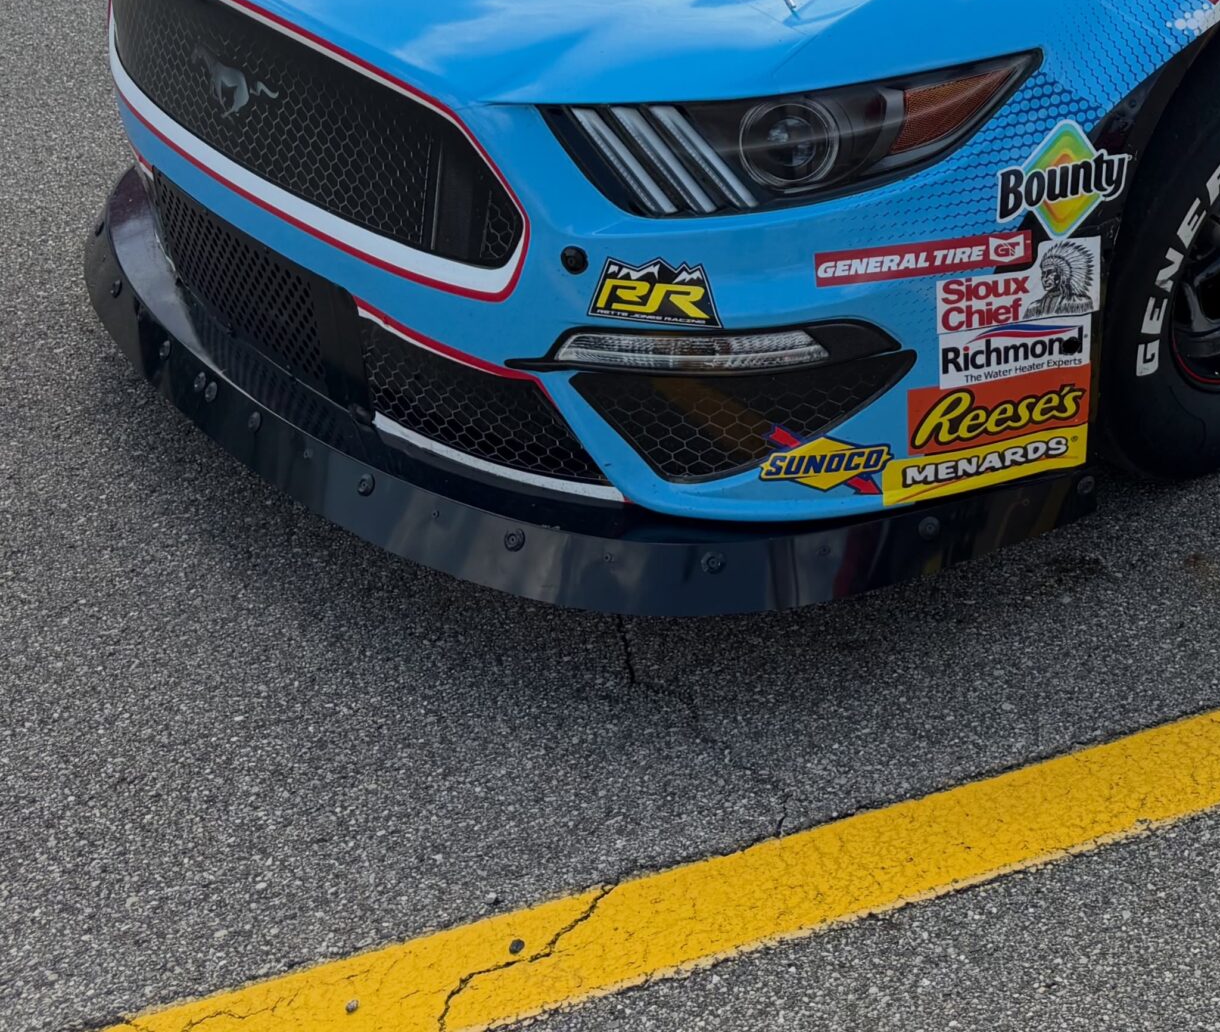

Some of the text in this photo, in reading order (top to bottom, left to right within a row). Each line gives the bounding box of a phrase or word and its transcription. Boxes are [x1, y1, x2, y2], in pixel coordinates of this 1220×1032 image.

[998, 152, 1127, 222] Bounty
[817, 252, 930, 278] GENERAL
[932, 245, 986, 266] TIRE
[941, 275, 1031, 306] Sioux
[941, 297, 1023, 332] Chief
[964, 356, 1083, 384] The Water Heater Experts
[913, 386, 1084, 448] Reese's
[767, 448, 884, 478] SUNOCO
[904, 436, 1069, 486] MENARDS
